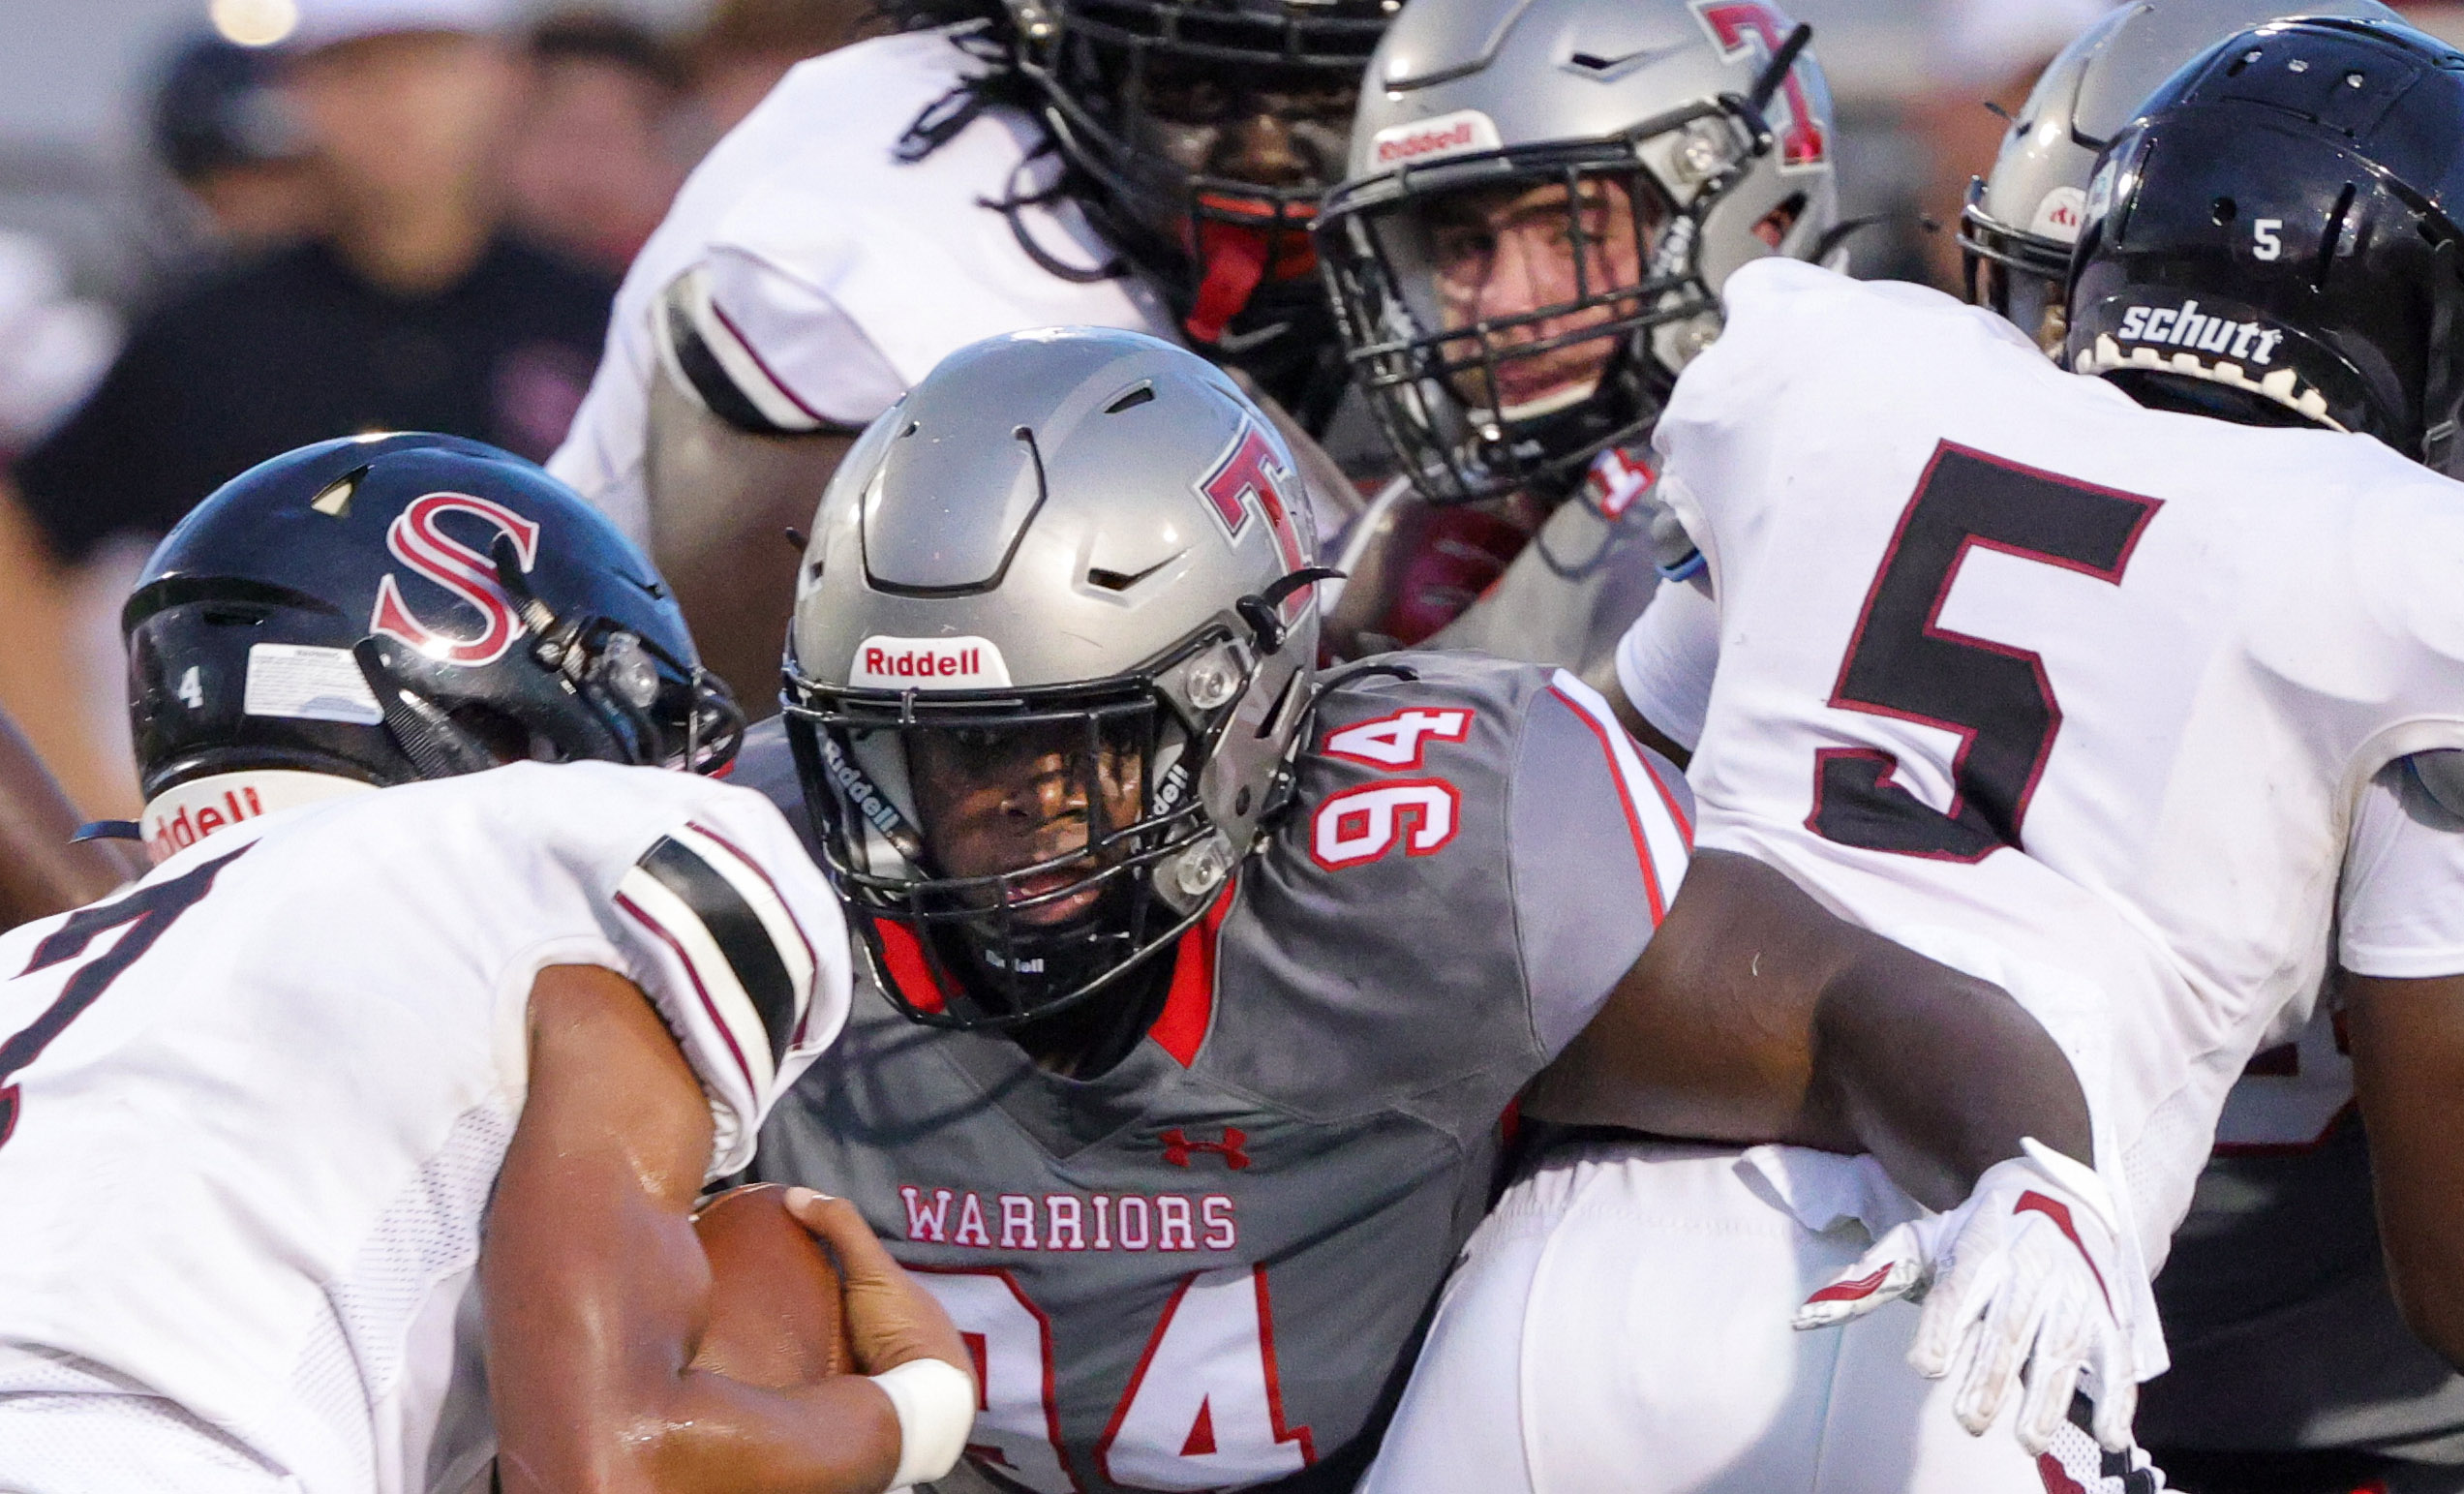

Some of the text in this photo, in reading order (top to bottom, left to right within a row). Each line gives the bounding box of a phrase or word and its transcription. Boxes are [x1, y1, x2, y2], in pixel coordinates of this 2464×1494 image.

[2252, 219, 2283, 261] 5
[2118, 300, 2284, 365] schutt
[371, 491, 540, 668] S
[865, 647, 980, 677] Riddell
[1803, 438, 2167, 865] 5
[176, 665, 203, 709] 4
[824, 738, 900, 832] Riddell
[1152, 763, 1190, 815] dell
[1311, 706, 1475, 872] 94
[898, 1185, 1239, 1250] WARRIORS
